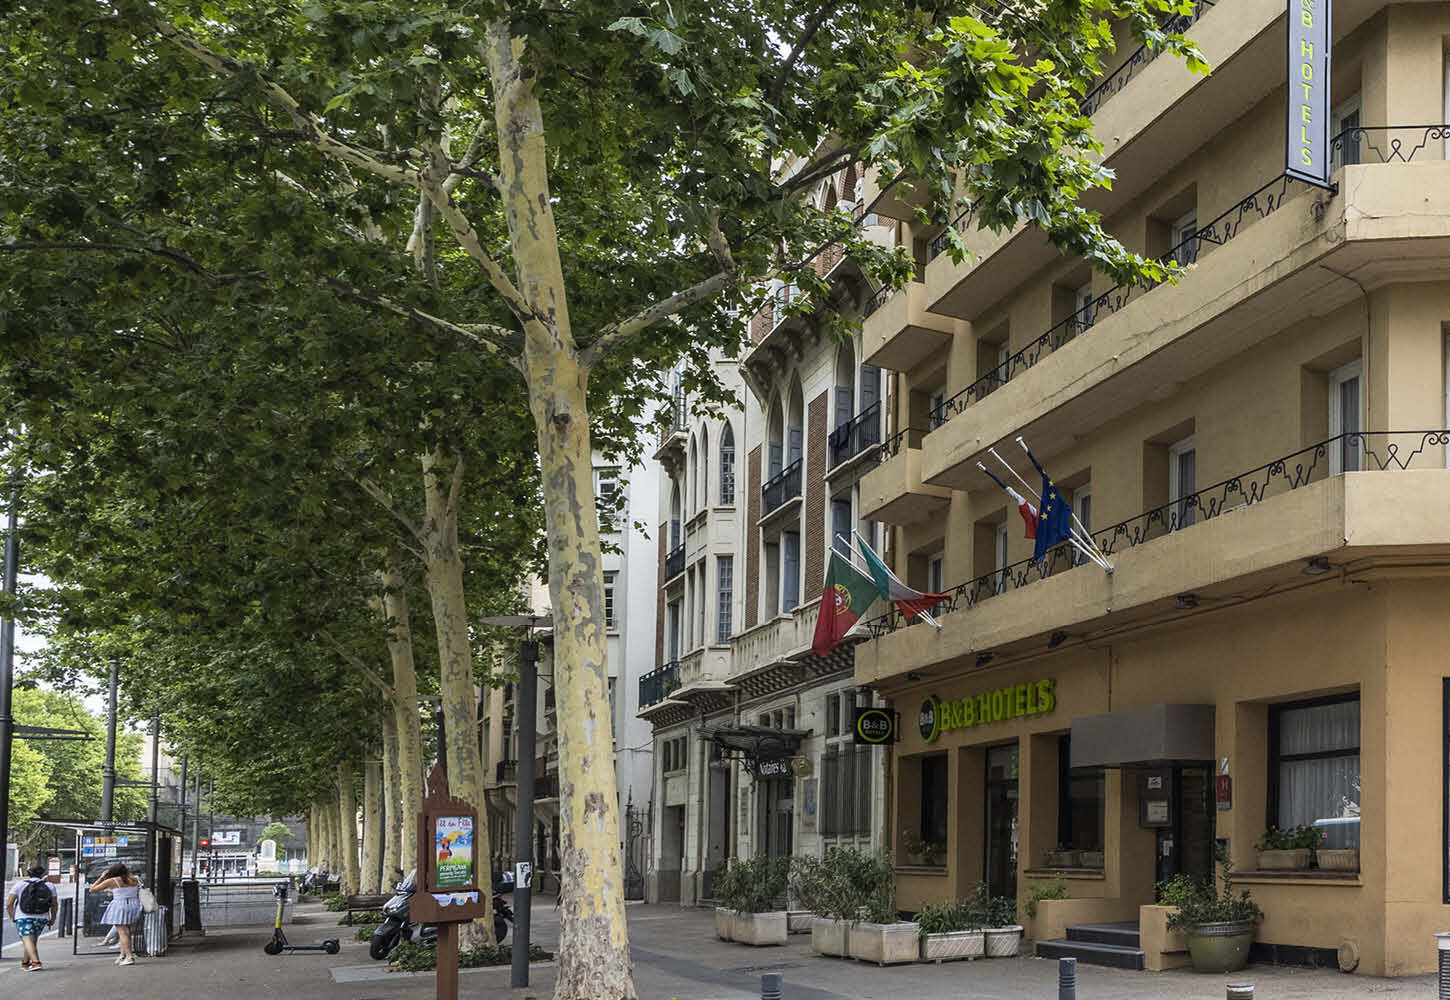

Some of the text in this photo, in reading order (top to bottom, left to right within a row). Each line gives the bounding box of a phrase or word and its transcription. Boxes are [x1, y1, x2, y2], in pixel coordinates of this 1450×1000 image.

[1300, 39, 1314, 166] HOTELS
[863, 719, 888, 730] B&B
[940, 679, 1055, 731] B&B HOTELS
